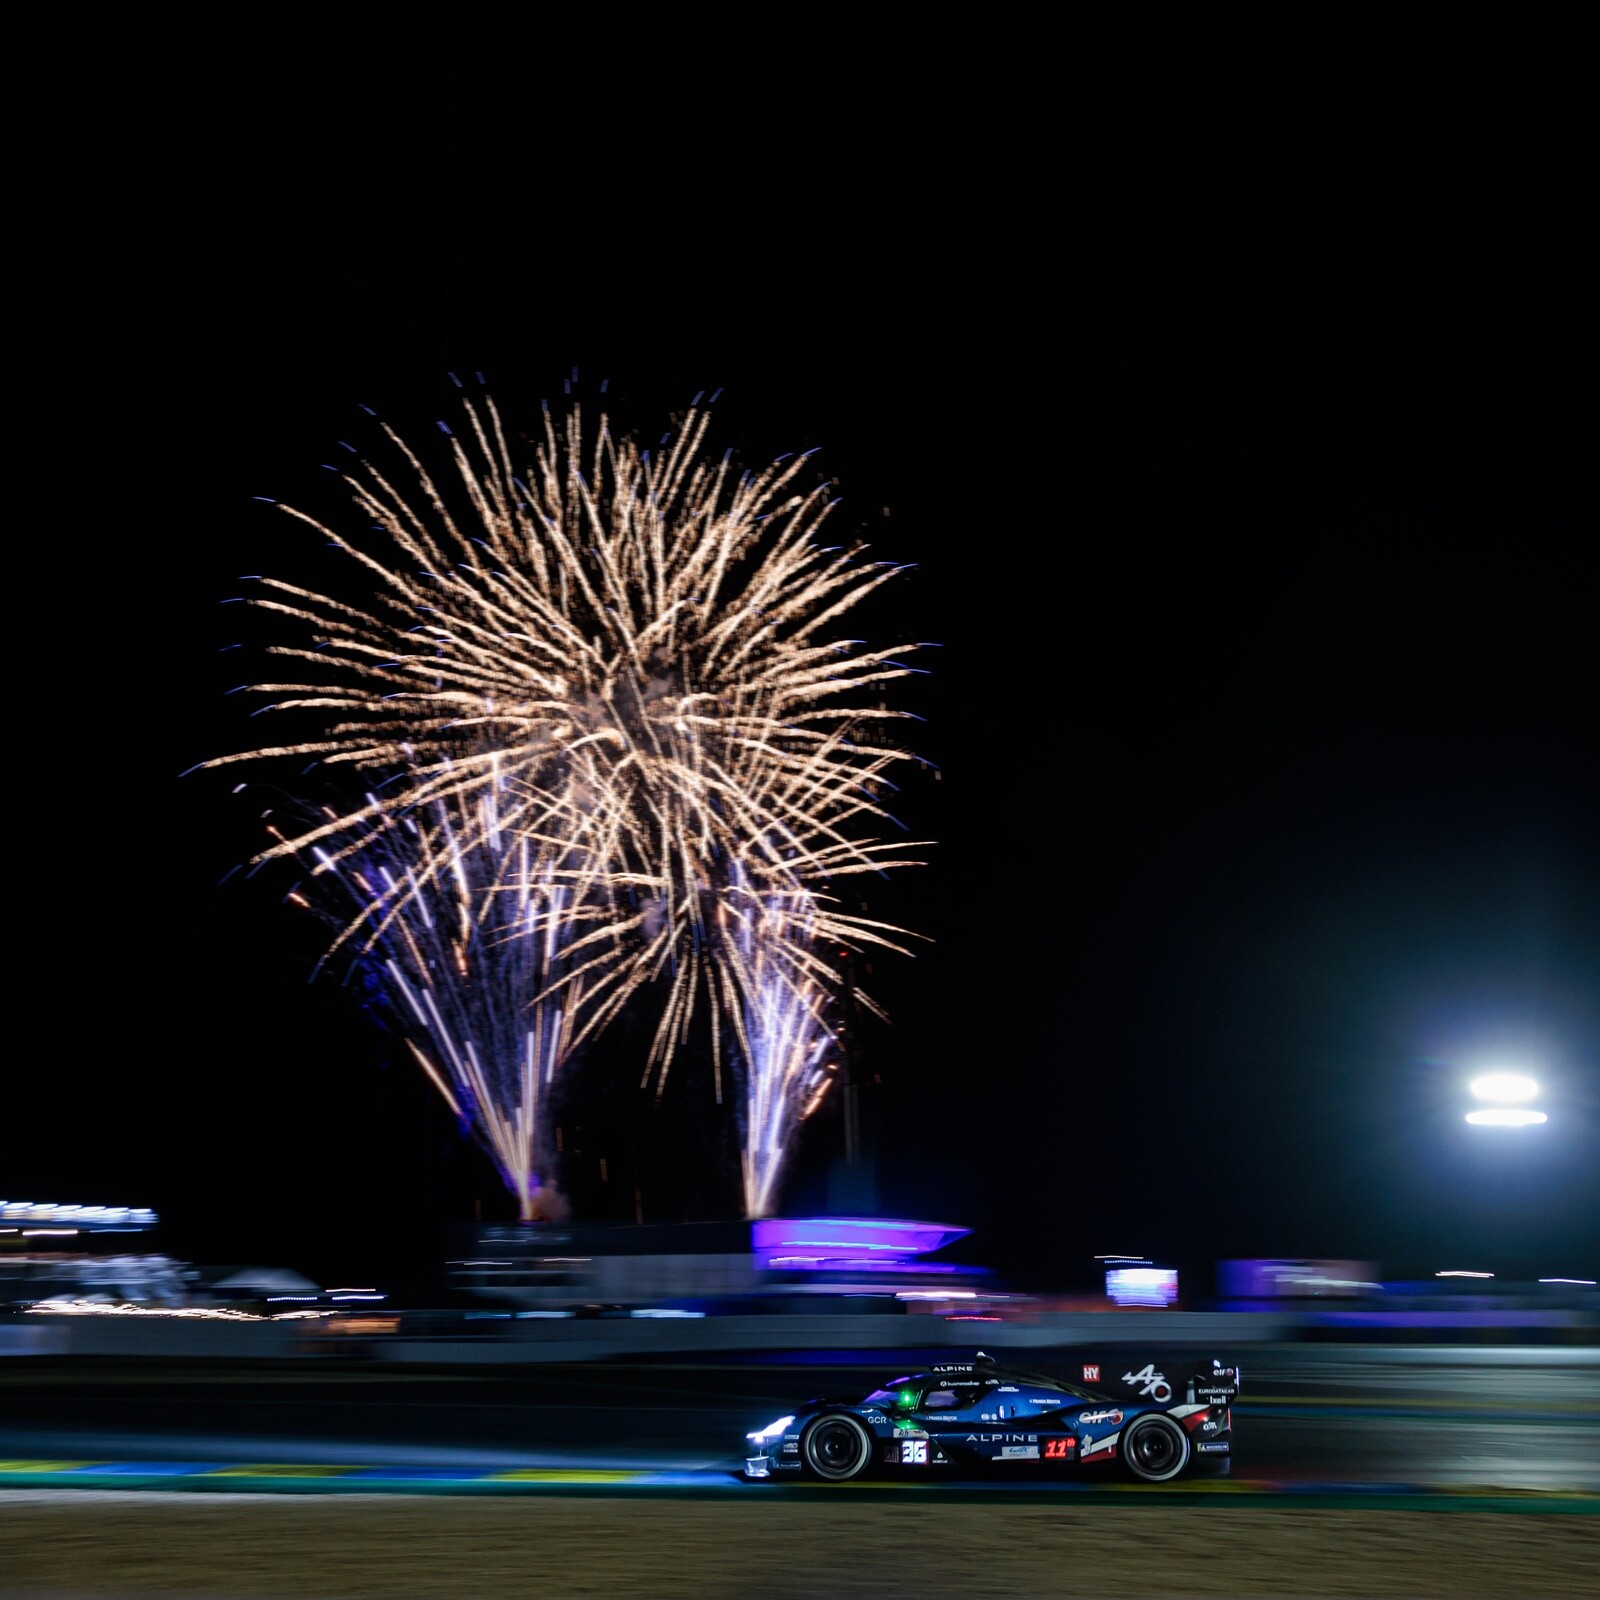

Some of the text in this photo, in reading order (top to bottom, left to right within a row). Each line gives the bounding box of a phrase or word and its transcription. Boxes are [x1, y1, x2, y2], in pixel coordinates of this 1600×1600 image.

[1083, 1367, 1099, 1380] HY
[868, 1416, 887, 1424] GCR
[1079, 1410, 1107, 1424] elf
[966, 1434, 1038, 1442] ALPINE
[902, 1440, 928, 1463] 36
